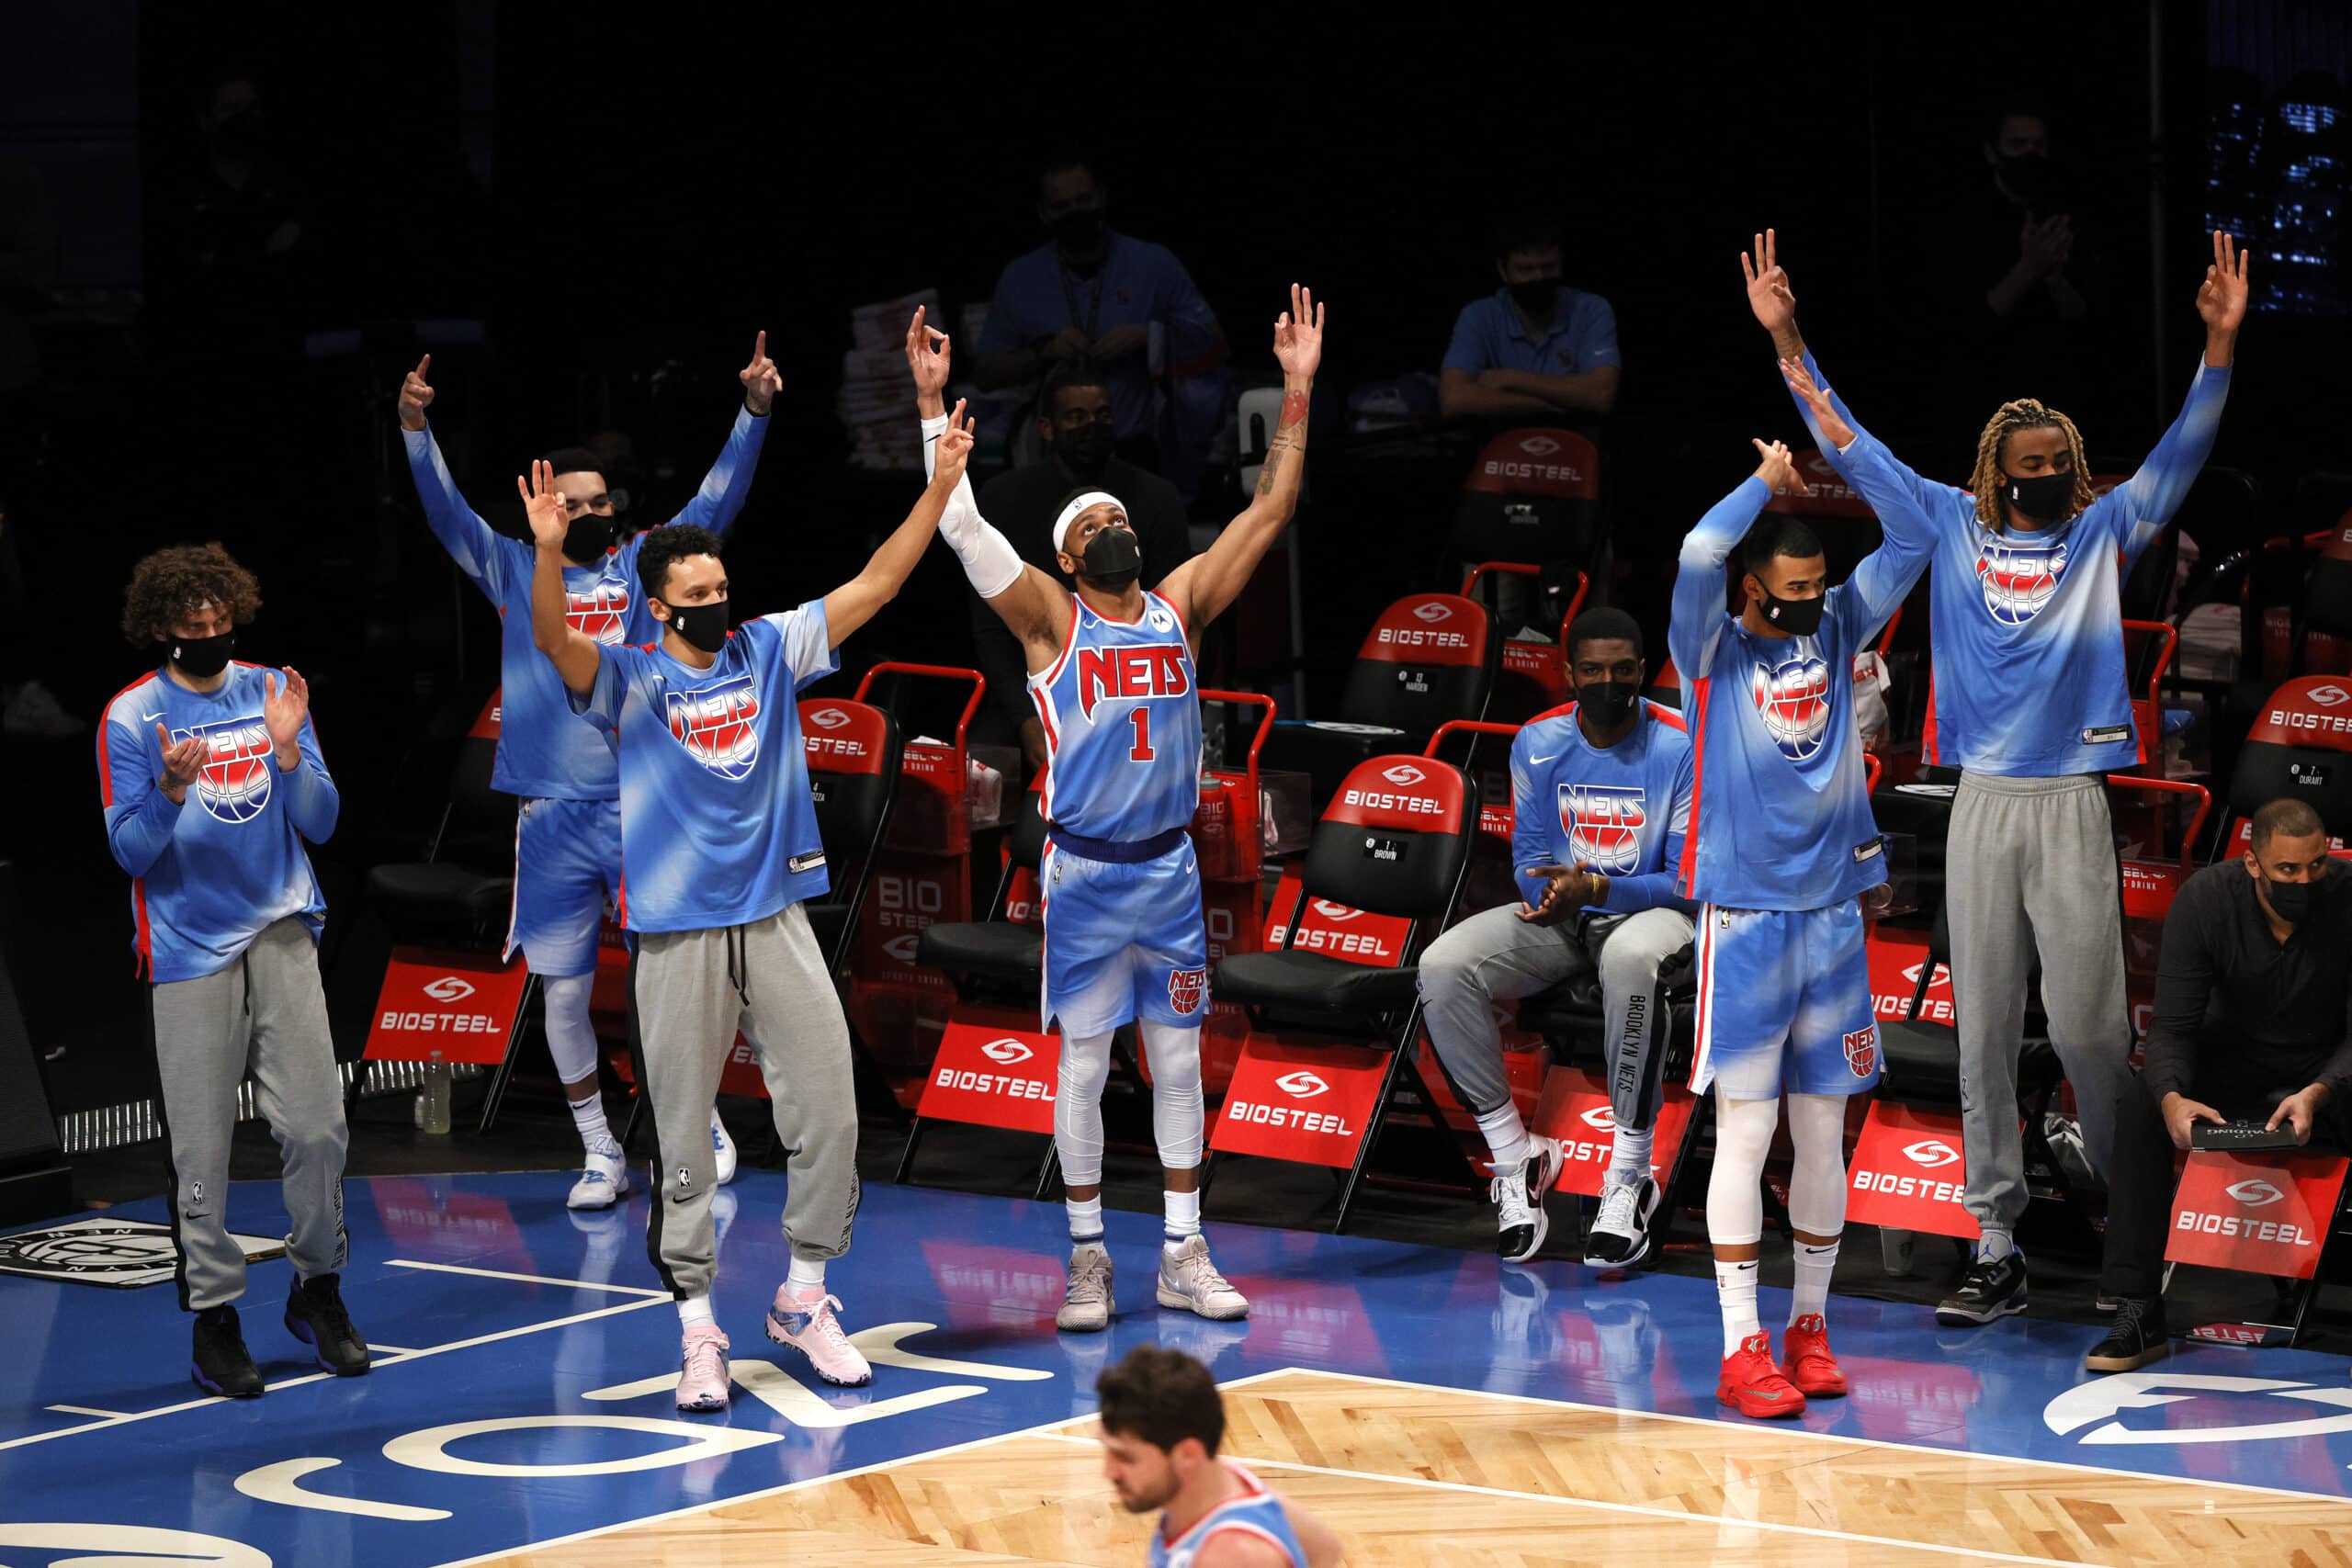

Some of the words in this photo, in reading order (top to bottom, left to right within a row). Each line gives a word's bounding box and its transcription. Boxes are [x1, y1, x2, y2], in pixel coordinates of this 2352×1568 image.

[1485, 461, 1582, 481] BIOSTEEL
[1377, 628, 1469, 648] BIOSTEEL
[1076, 643, 1188, 727] NETS
[665, 674, 760, 744] NETS
[2269, 710, 2352, 733] BIOSTEE
[1129, 705, 1155, 761] 1
[1344, 789, 1445, 815] BIOSTEEL
[1557, 783, 1646, 839] NETS
[1374, 848, 1396, 861] BROWN
[878, 875, 942, 912] BIO
[2132, 880, 2156, 891] DRINK
[1269, 925, 1390, 956] BOSTEEL
[1168, 968, 1206, 995] NETS
[379, 1011, 502, 1033] BIOSTEEL
[1622, 995, 1646, 1058] BROOKLYN
[1843, 1024, 1875, 1061] NETS
[935, 1068, 1056, 1101] BIOSTEEL
[1616, 1062, 1636, 1093] NETS
[1228, 1101, 1353, 1136] BIOSTEEL
[1853, 1169, 1965, 1203] BIOSTEE
[2176, 1210, 2312, 1246] BIOSTEEL
